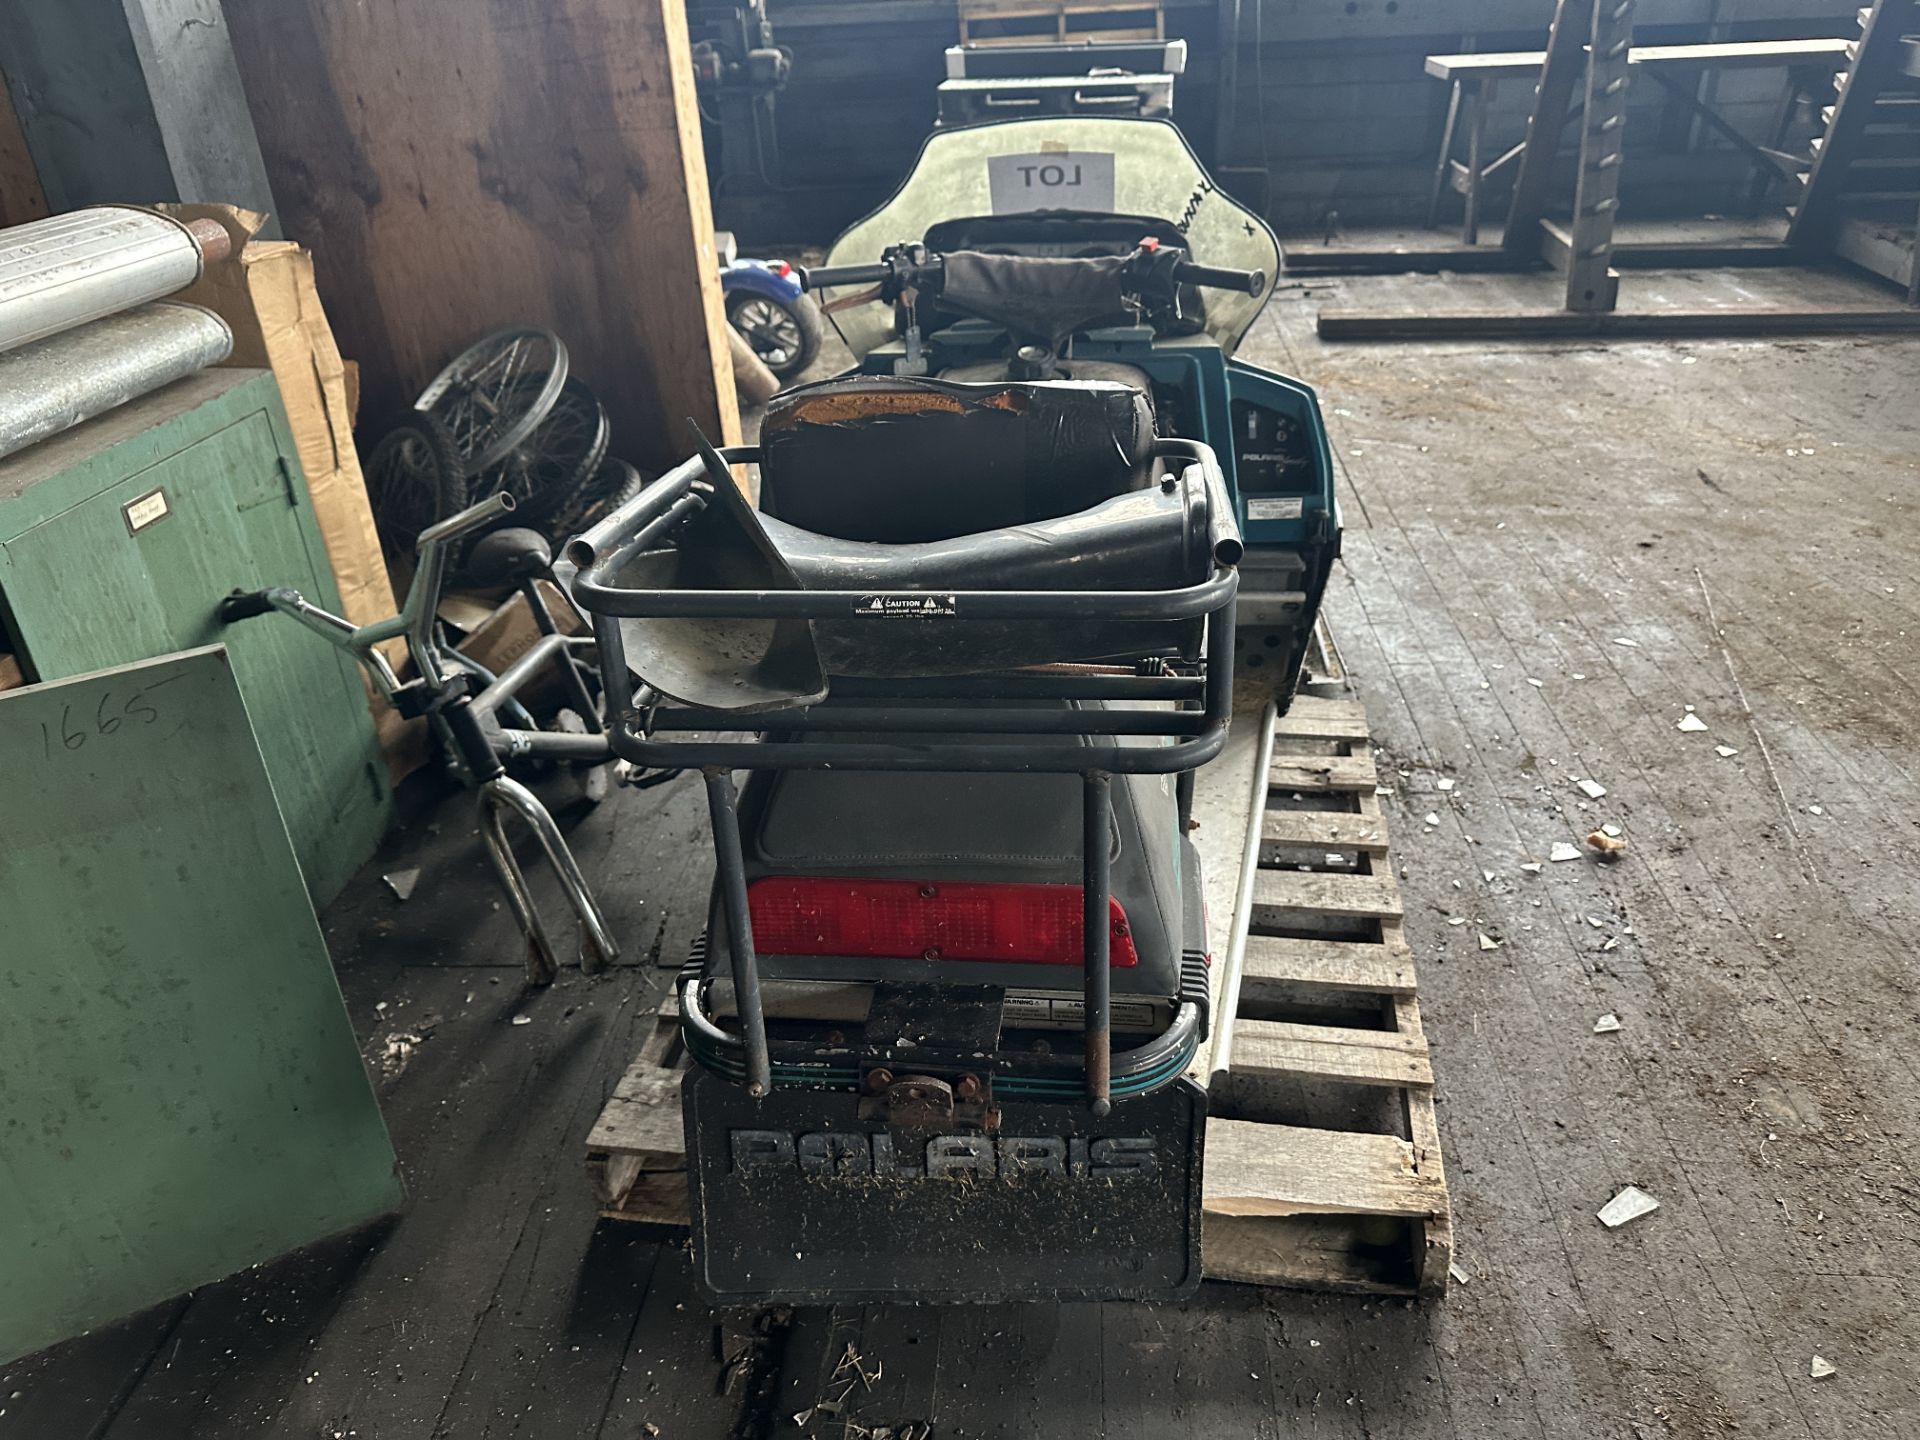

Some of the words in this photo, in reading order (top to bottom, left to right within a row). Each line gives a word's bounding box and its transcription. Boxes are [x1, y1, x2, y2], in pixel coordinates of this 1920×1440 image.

[885, 600, 921, 608] CAUTION
[40, 671, 192, 759] 1665
[729, 1128, 1158, 1179] POLARIS
